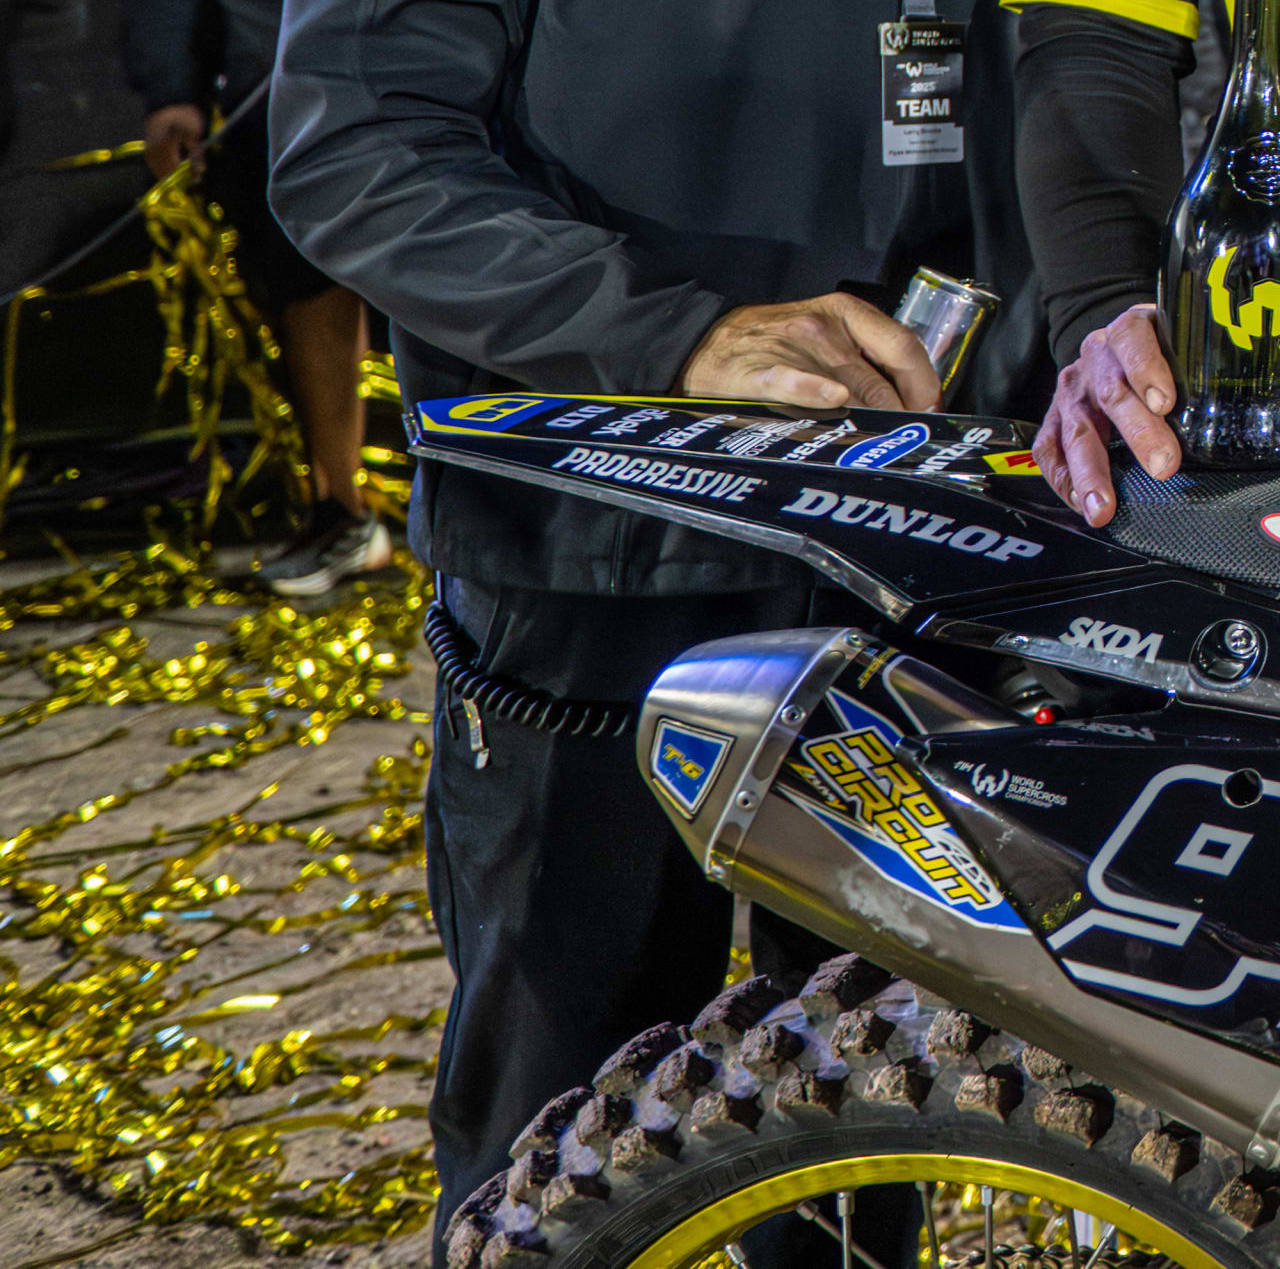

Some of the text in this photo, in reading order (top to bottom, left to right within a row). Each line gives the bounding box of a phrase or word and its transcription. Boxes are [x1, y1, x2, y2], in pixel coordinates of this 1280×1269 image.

[896, 98, 951, 119] TEAM
[552, 445, 764, 503] PROGRESSIVE
[781, 485, 1046, 562] DUNLOP
[1057, 616, 1165, 665] SKDA
[843, 729, 950, 829] PRO
[1007, 783, 1069, 807] SUPERCROSS
[1011, 774, 1046, 790] WORLD
[805, 740, 992, 910] CIRCUIT
